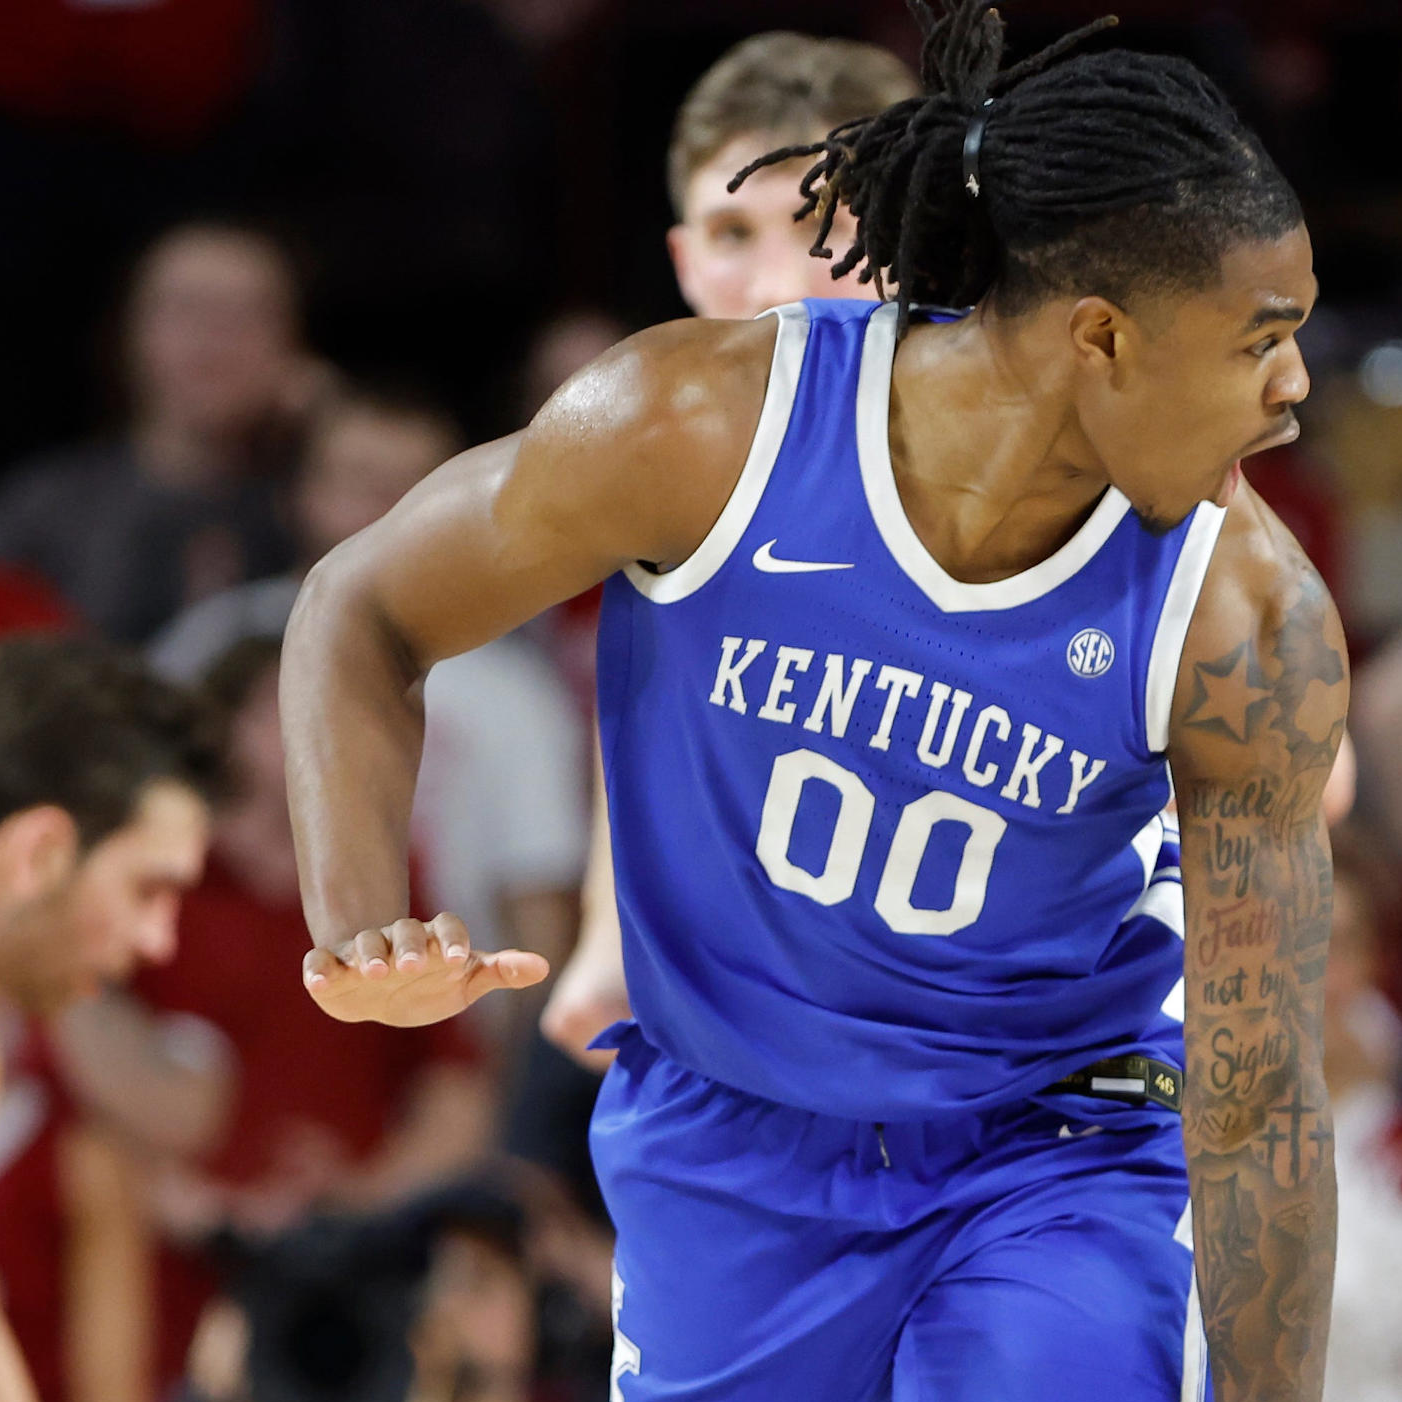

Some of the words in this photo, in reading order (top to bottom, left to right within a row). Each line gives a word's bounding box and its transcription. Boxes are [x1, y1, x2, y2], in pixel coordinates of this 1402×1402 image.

[1069, 631, 1112, 675] SEC
[708, 635, 1107, 815] KENTUCKY
[755, 747, 1008, 937] 00
[1154, 1072, 1176, 1097] 46
[1210, 1028, 1288, 1092] Sight
